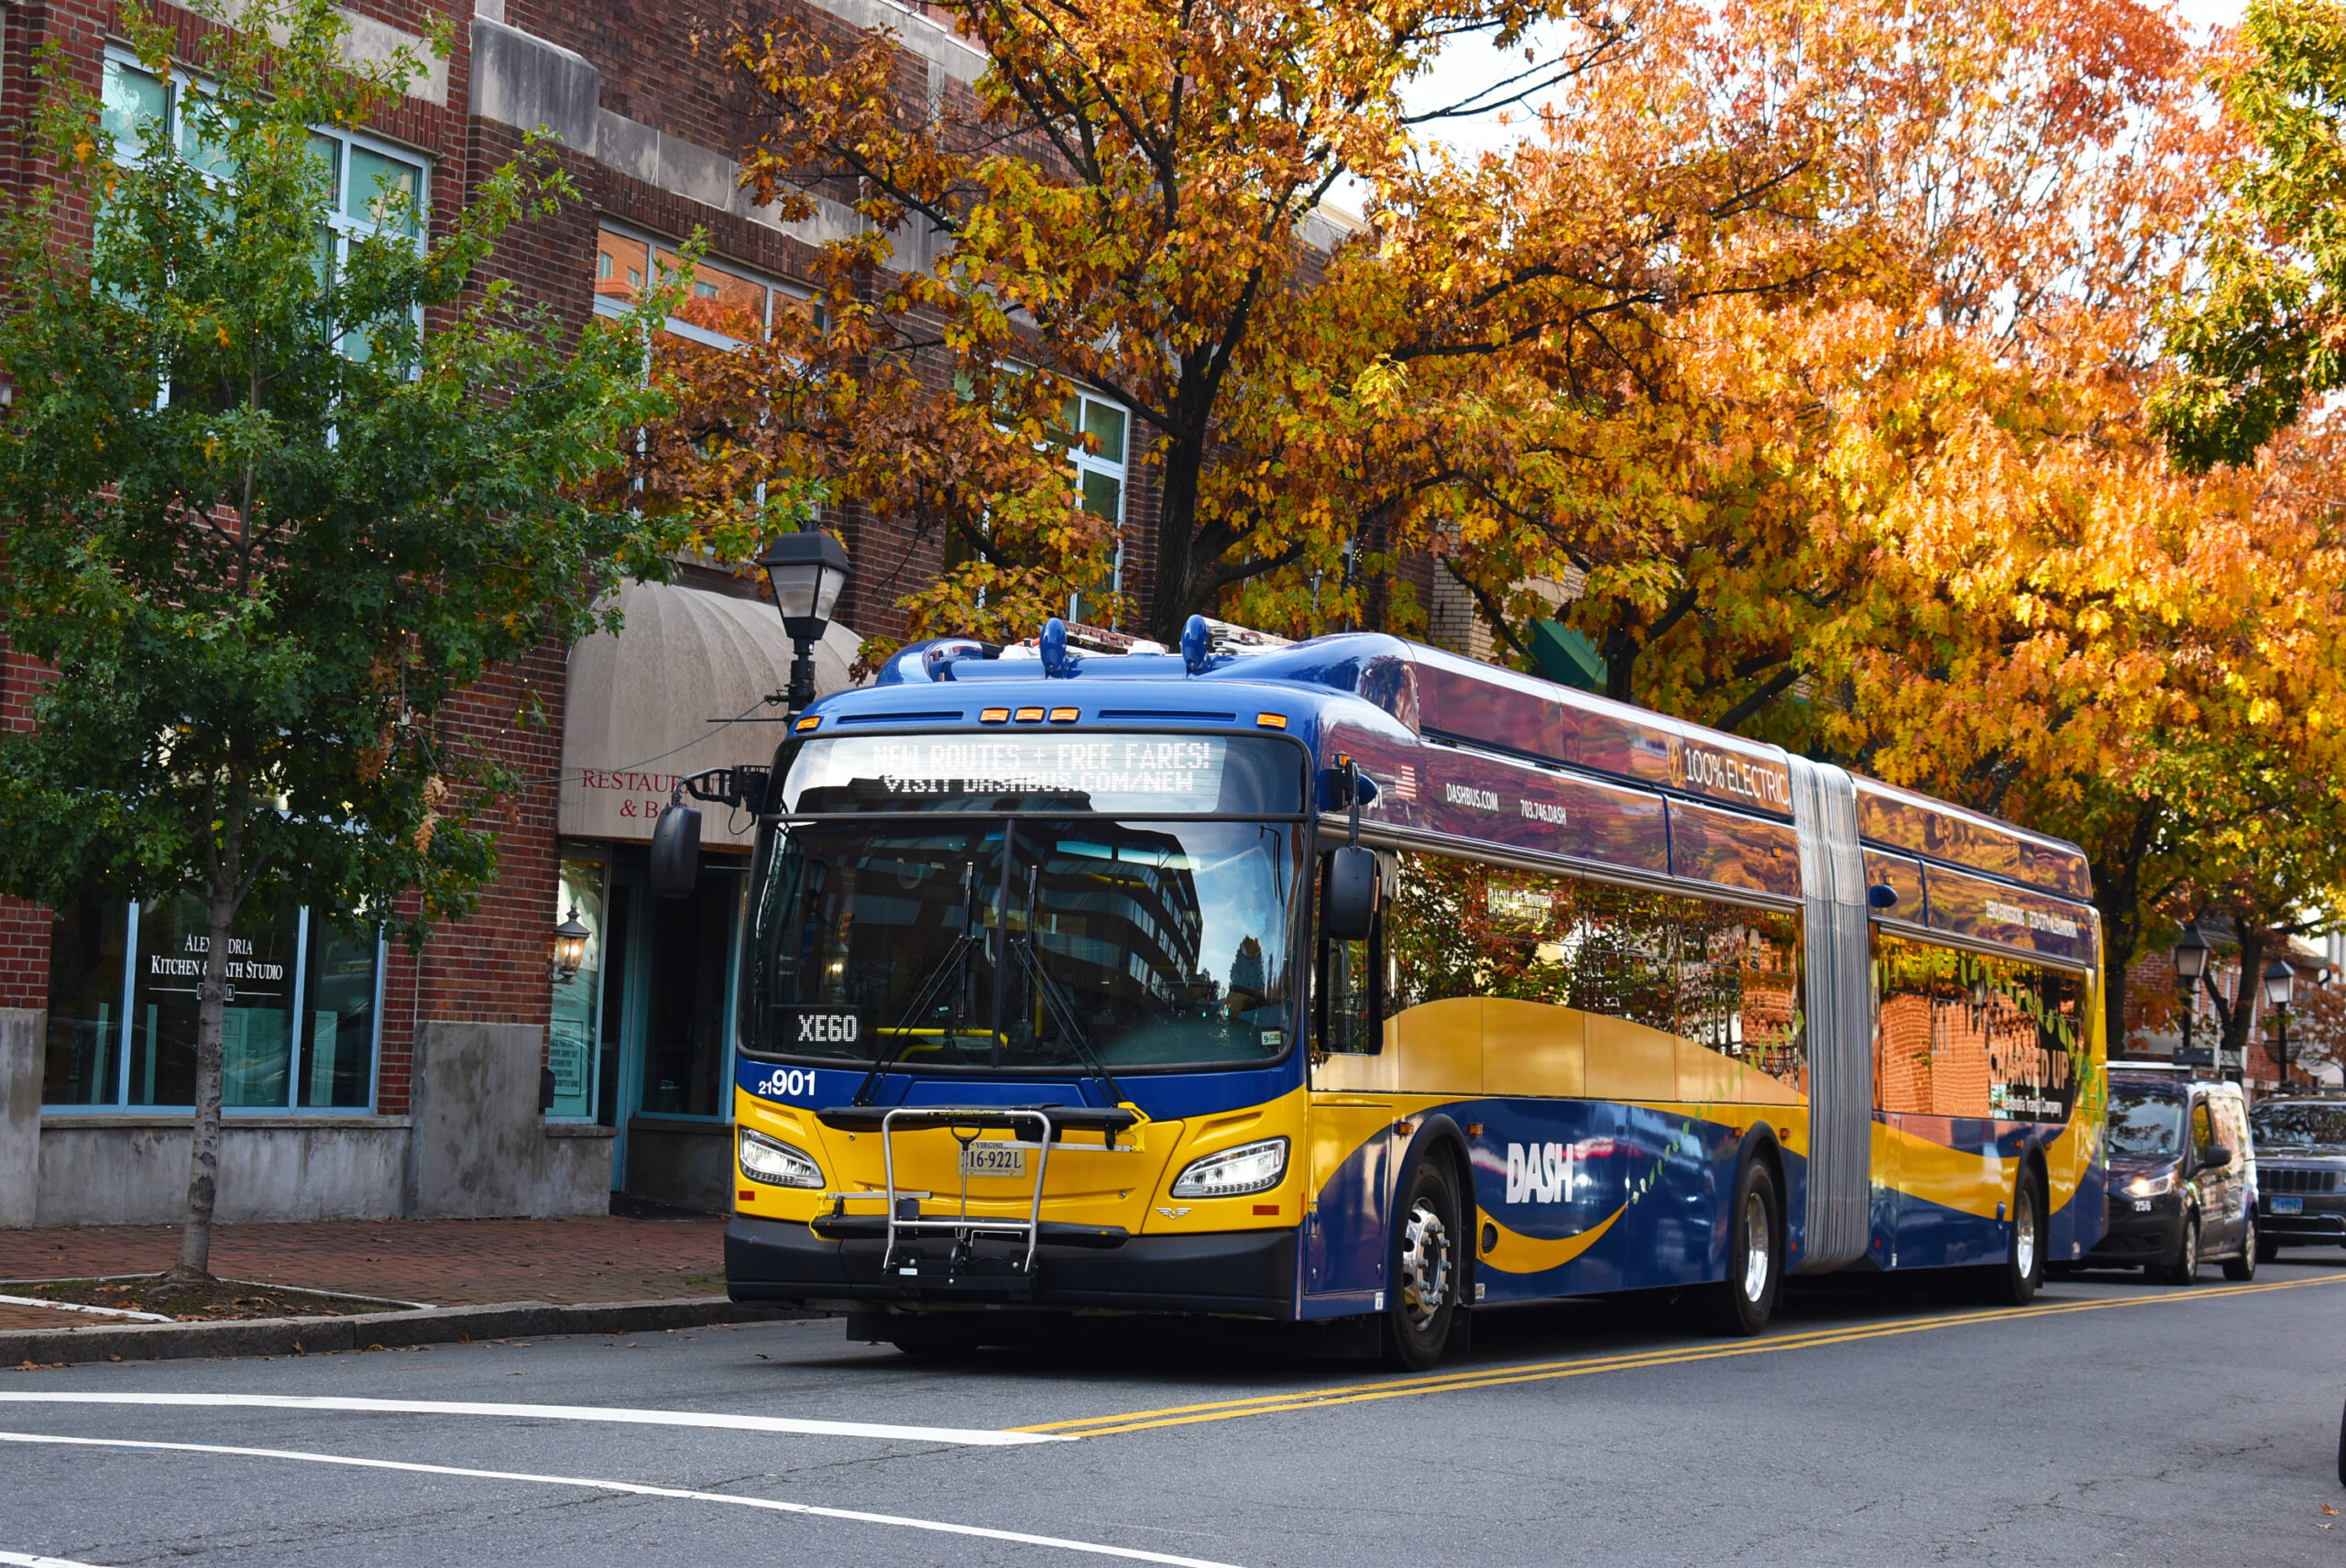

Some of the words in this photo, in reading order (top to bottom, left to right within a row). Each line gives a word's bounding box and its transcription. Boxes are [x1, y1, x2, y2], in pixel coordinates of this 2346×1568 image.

[873, 744, 916, 771] NEW
[930, 743, 1021, 770] ROUTES
[1058, 743, 1113, 770] FREE
[1125, 742, 1210, 770] FARES!
[882, 773, 950, 794] VISIT
[963, 772, 1193, 793] DASHBUS.COM/NEW
[1685, 748, 1725, 789] 100%
[1726, 759, 1789, 806] ELECTRIC
[619, 799, 638, 817] &
[1446, 783, 1499, 812] DASHBUS.COM
[1519, 799, 1567, 825] 703.746.DASH
[151, 955, 200, 976] KITCHEN
[246, 960, 283, 981] STUDIO
[798, 1014, 857, 1042] XE60
[1989, 1043, 2050, 1089] CHARGED
[2052, 1049, 2069, 1090] UP
[975, 1142, 1009, 1150] VIRGINI
[1506, 1142, 1575, 1204] DASH
